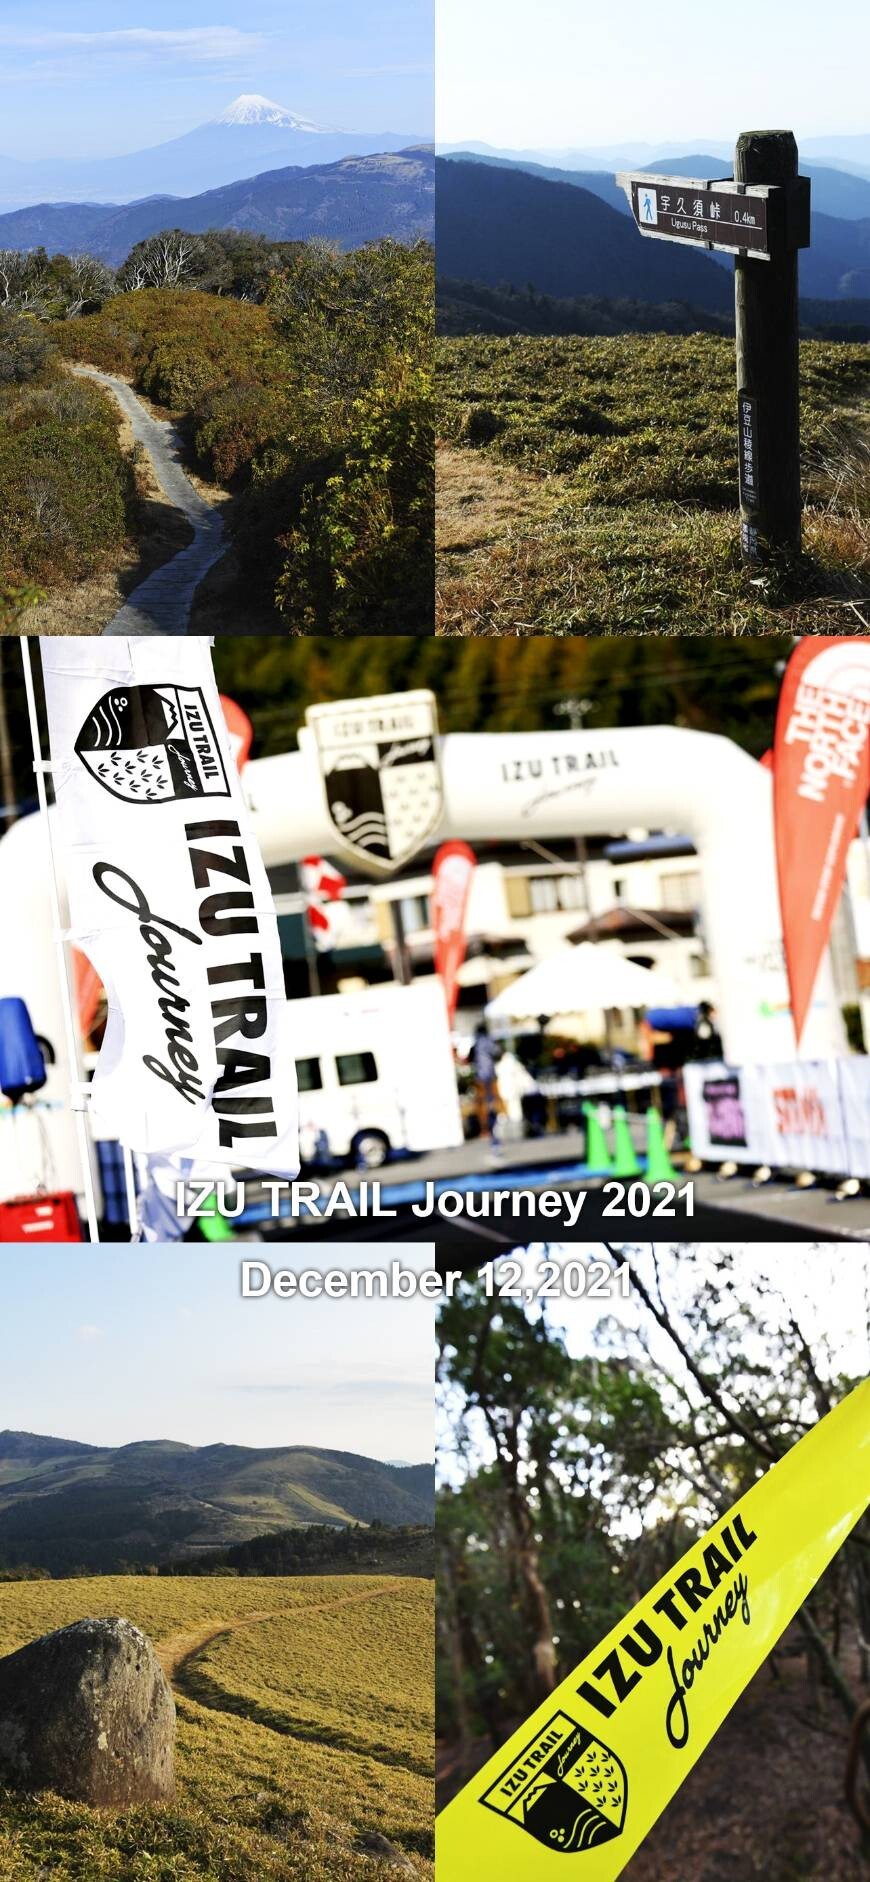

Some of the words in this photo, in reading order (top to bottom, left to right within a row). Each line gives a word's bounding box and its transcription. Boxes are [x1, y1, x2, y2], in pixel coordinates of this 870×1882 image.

[660, 195, 721, 220] 宇久須峠
[734, 210, 756, 226] 0.4km
[671, 217, 692, 231] Ugusu
[692, 221, 708, 233] Pass
[184, 704, 205, 732] IZU
[784, 684, 820, 745] THE
[797, 691, 847, 802] NORTH
[831, 697, 870, 781] FACE
[168, 744, 198, 791] Journey
[193, 734, 220, 780] TRAIL
[501, 758, 543, 783] IZU
[551, 749, 620, 776] TRAIL
[184, 819, 261, 940] IZU
[92, 861, 206, 1105] Journey
[206, 951, 278, 1149] TRAIL
[575, 1618, 663, 1719] IZU
[652, 1513, 758, 1631] TRAIL
[666, 1572, 751, 1749] Journey
[499, 1768, 529, 1797] IZU
[523, 1730, 564, 1770] TRAIL
[557, 1732, 581, 1777] Journey
